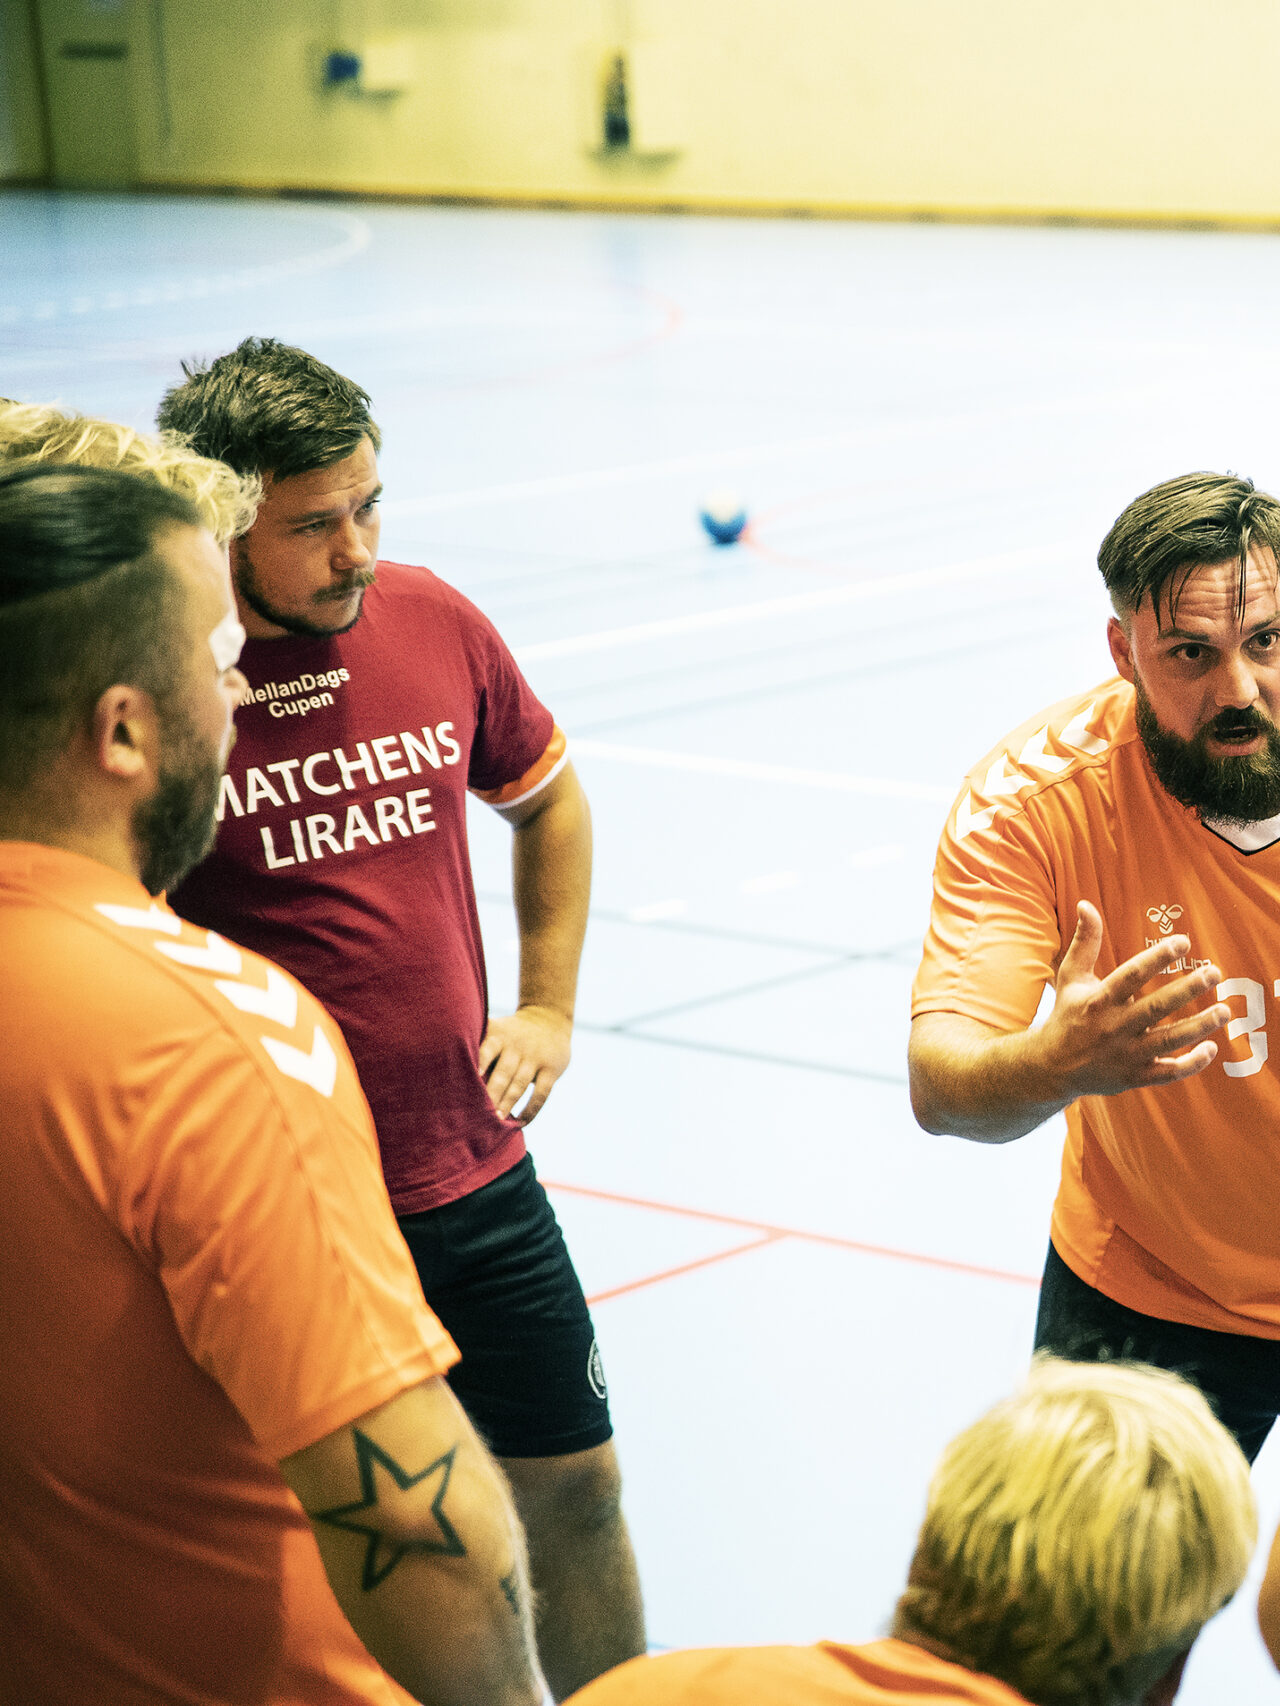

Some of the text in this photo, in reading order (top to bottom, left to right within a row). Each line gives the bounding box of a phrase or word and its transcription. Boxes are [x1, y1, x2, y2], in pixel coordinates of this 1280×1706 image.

[241, 667, 351, 707] MellanDags
[268, 691, 335, 718] Cupen
[260, 788, 436, 870] LIRARE
